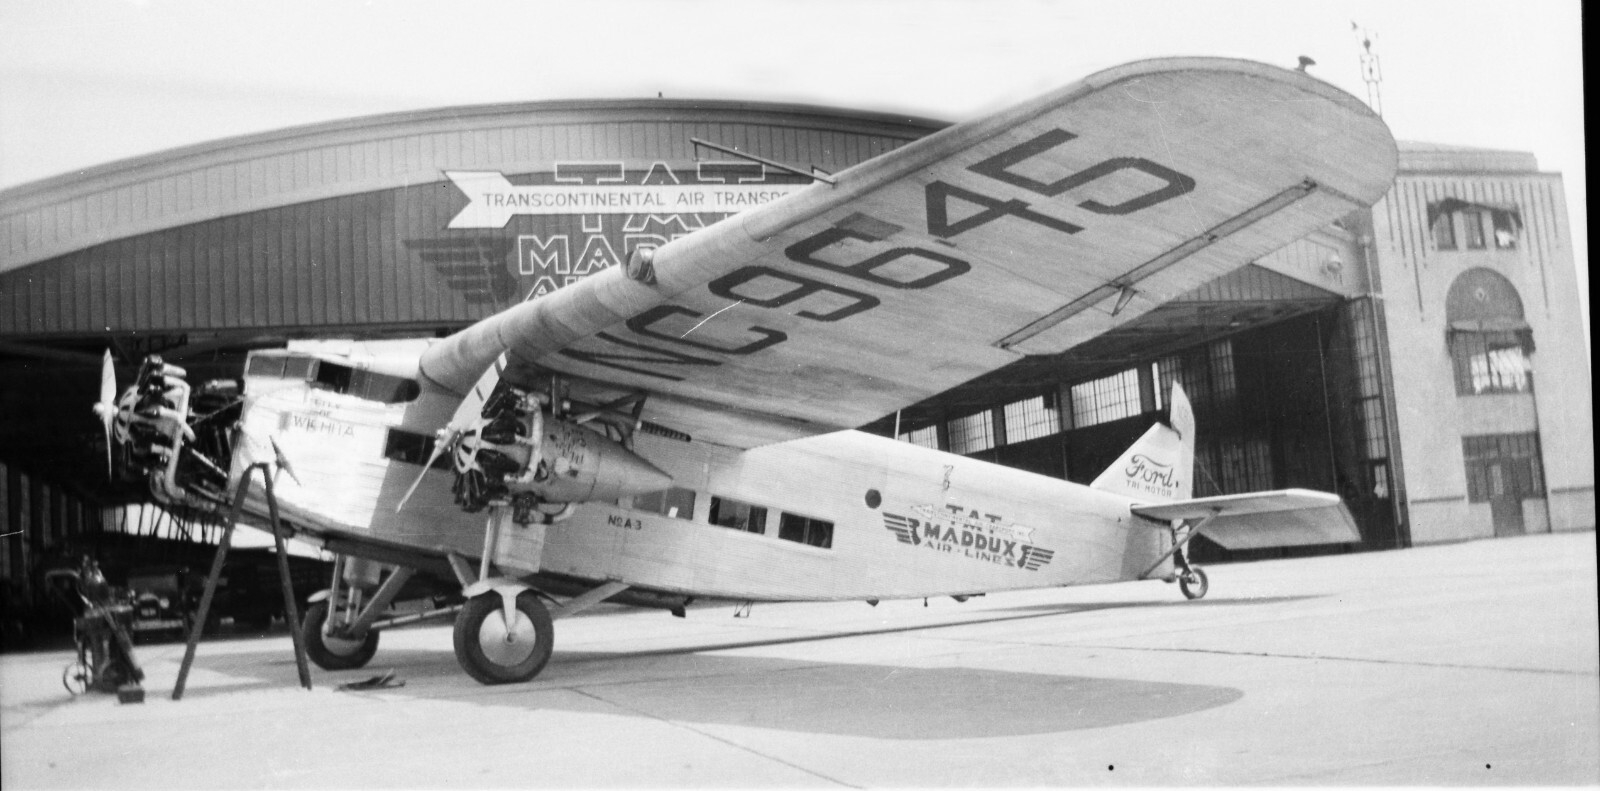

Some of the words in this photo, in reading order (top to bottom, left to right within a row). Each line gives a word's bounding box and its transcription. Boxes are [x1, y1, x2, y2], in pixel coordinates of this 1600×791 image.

[482, 192, 666, 207] TRANSCONTINENTAL
[677, 191, 705, 206] AIR
[558, 127, 1196, 382] NC9645
[1125, 454, 1174, 488] Ford
[1126, 480, 1140, 490] TRI
[1145, 484, 1172, 497] MOTOR
[924, 521, 1017, 558] MADDUX
